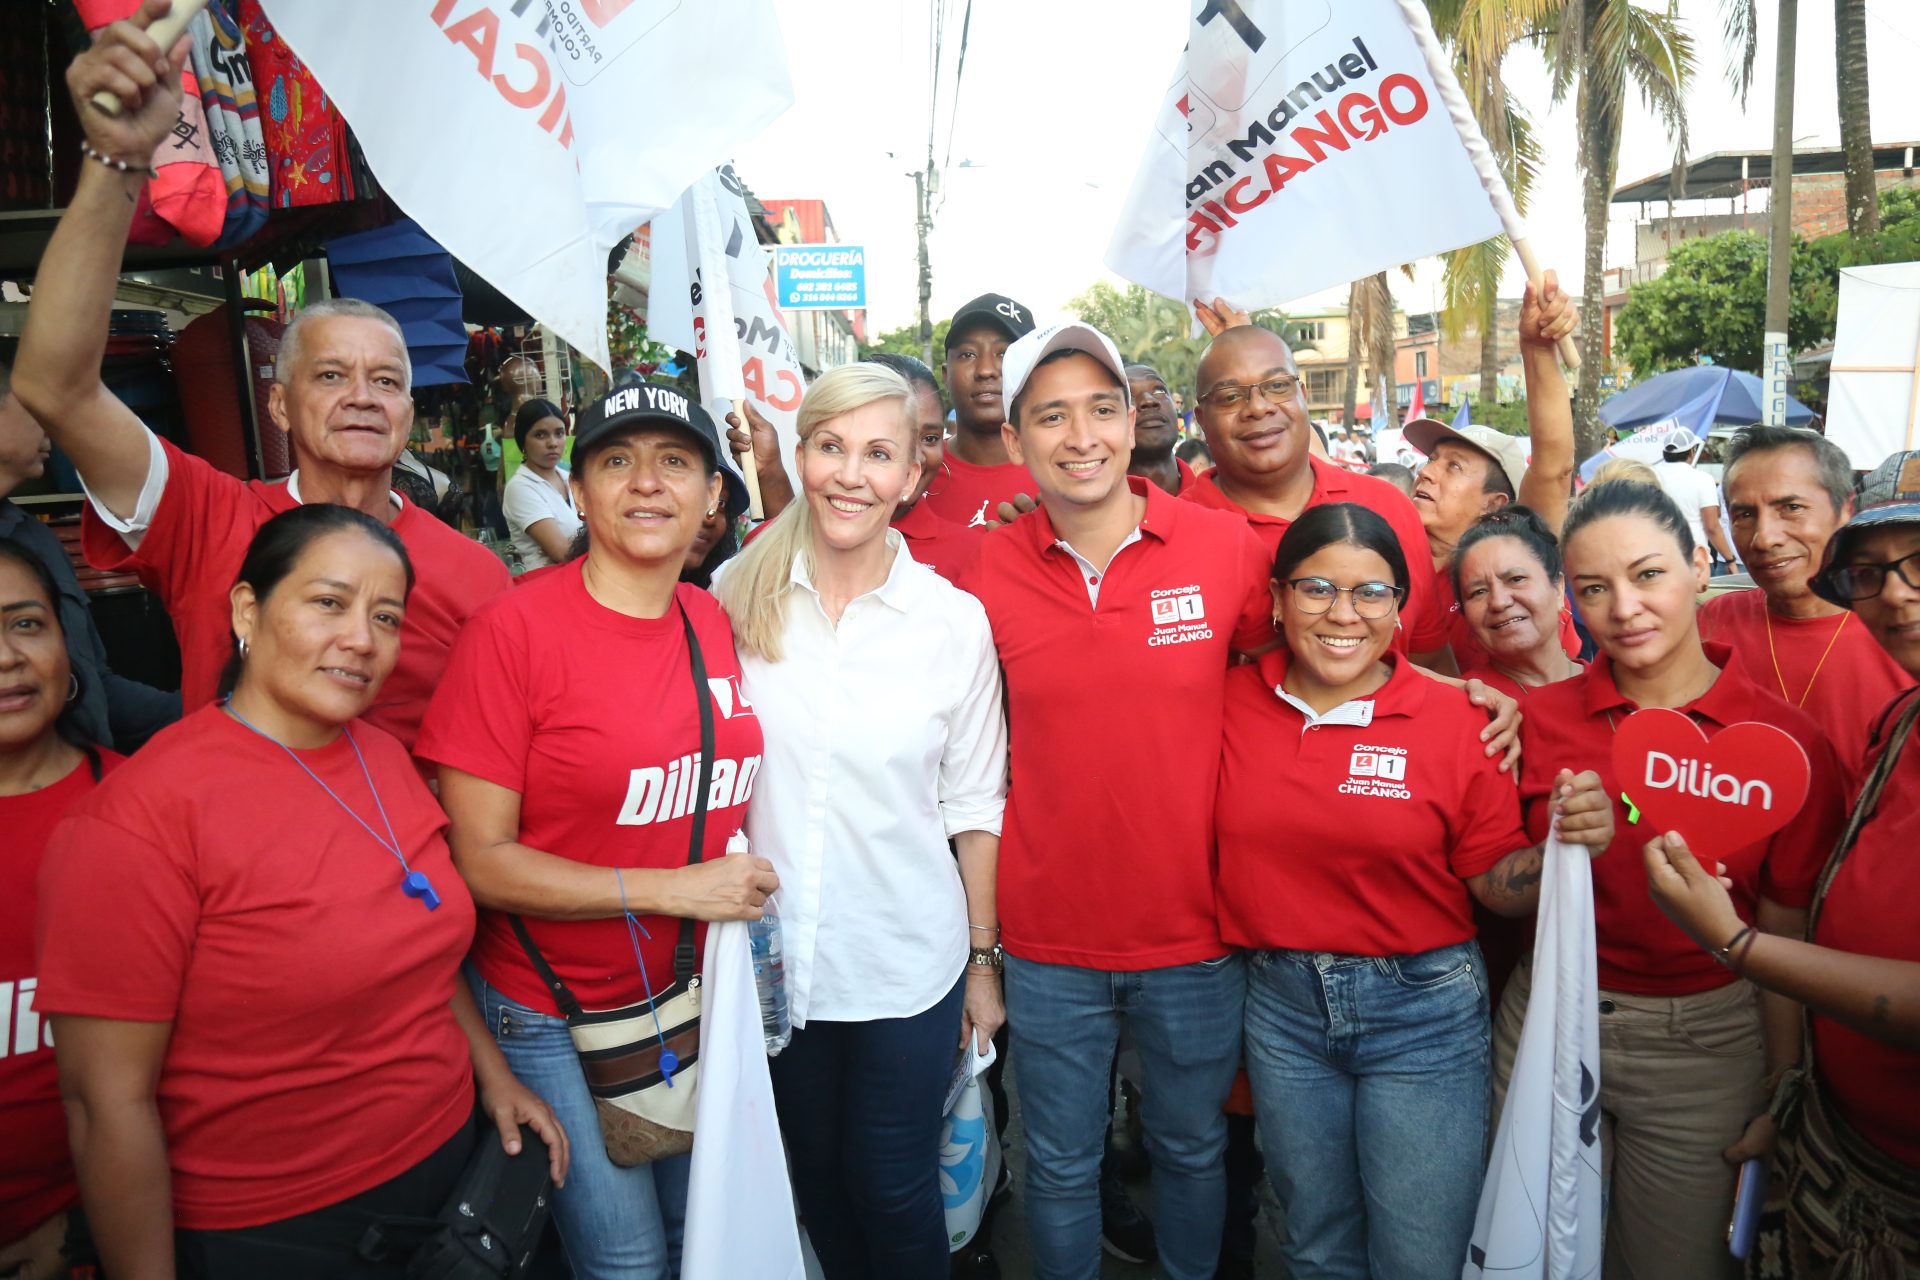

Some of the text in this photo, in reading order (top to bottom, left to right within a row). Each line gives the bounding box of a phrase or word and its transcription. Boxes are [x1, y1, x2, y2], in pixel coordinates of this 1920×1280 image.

[1226, 35, 1379, 163] Manuel
[779, 249, 863, 267] DROGUERÍA
[604, 386, 690, 422] NEW YORK
[1151, 585, 1201, 598] Concejo
[1185, 598, 1194, 615] 1
[1153, 622, 1208, 636] Juan Manuel
[1147, 629, 1213, 647] CHICANGO
[1353, 744, 1408, 756] Concejo
[1386, 759, 1395, 774] 1
[1346, 777, 1406, 790] Juan Manuel
[1645, 750, 1772, 810] Dilian
[615, 752, 762, 826] Dilian
[1338, 784, 1411, 800] CHICANGO
